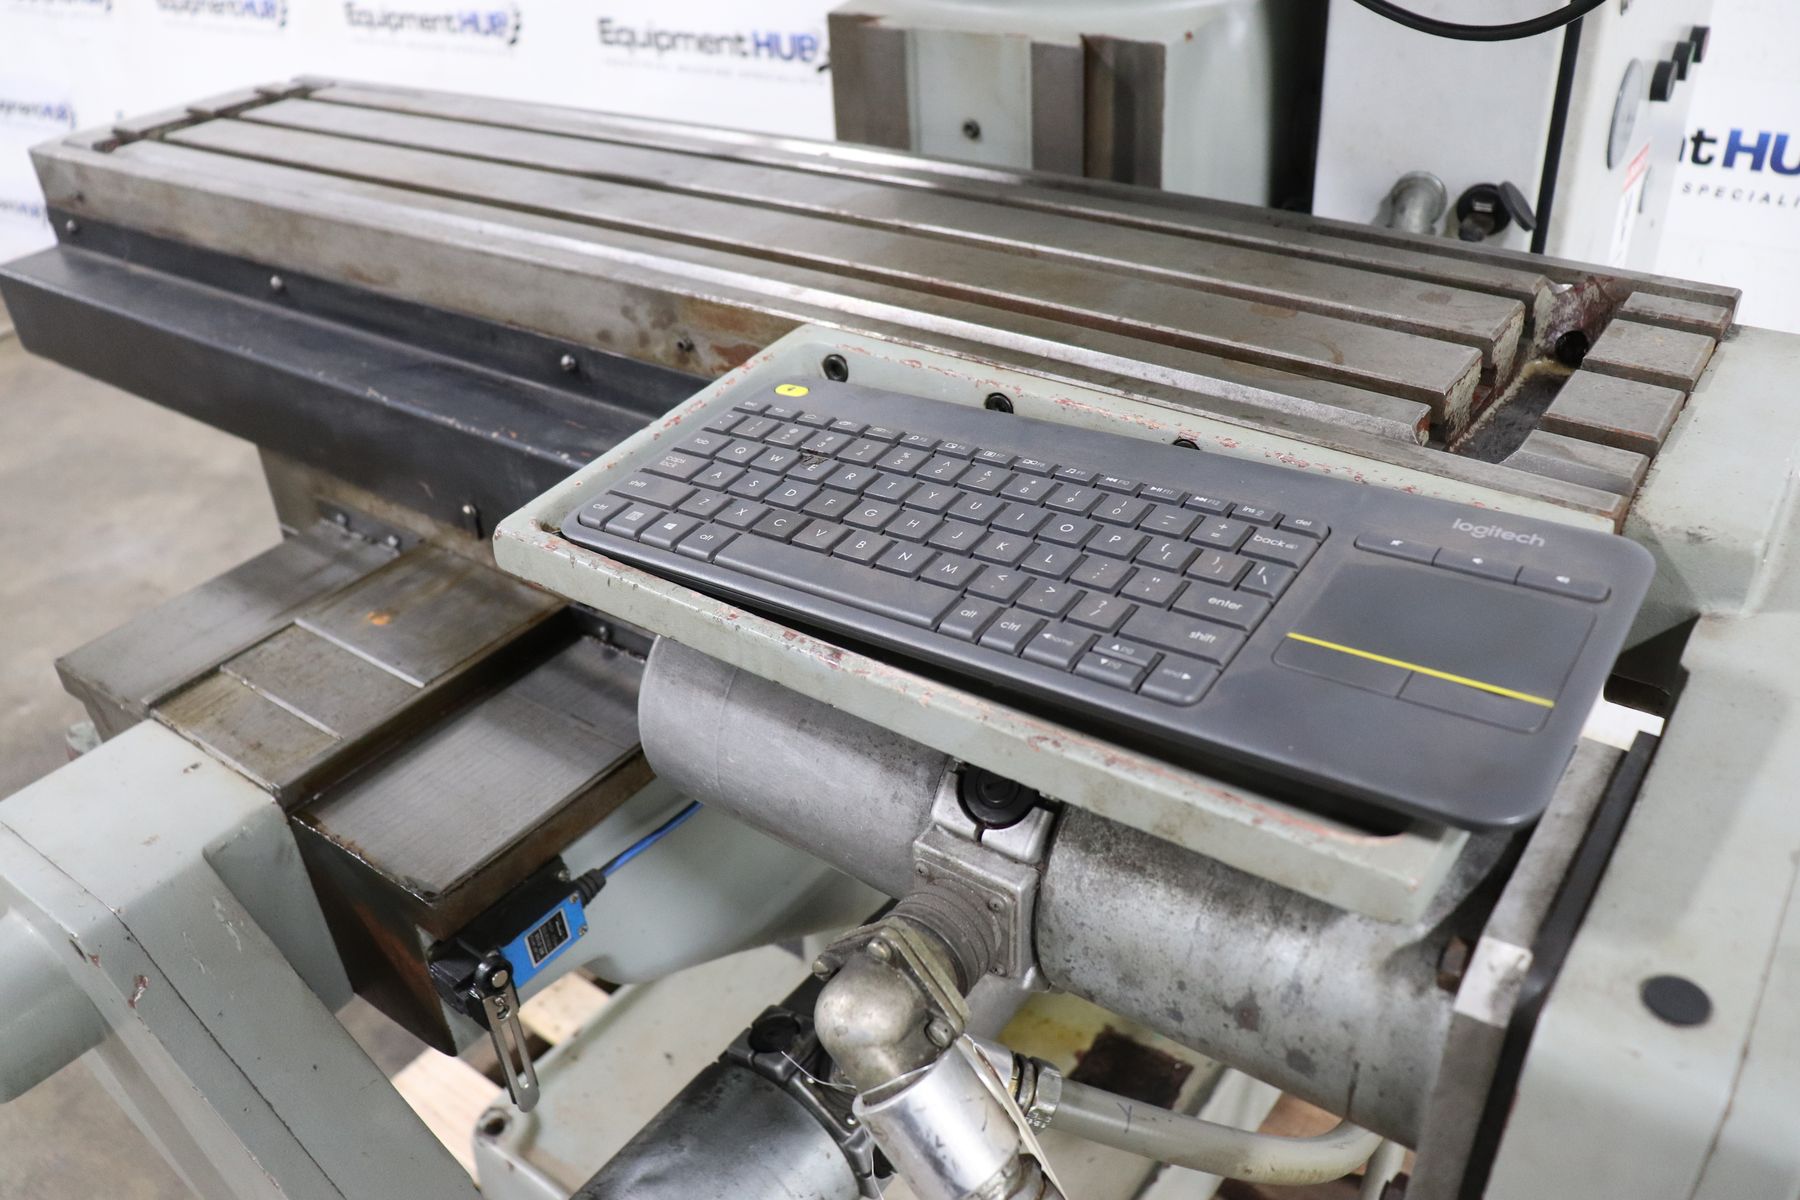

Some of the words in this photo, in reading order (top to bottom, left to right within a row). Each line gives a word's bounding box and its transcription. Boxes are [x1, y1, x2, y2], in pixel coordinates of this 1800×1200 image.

[598, 17, 818, 63] EquipmentHUB
[735, 446, 747, 455] Q
[770, 454, 784, 462] W
[807, 464, 818, 472] E
[711, 471, 723, 479] A
[845, 472, 857, 481] R
[749, 480, 760, 488] S
[887, 481, 897, 490] T
[784, 489, 797, 498] D
[928, 491, 939, 500] Y
[824, 498, 837, 507] F
[970, 502, 982, 511] U
[735, 507, 749, 517] X
[864, 508, 878, 518] G
[773, 518, 787, 527] C
[906, 519, 921, 529] H
[815, 528, 828, 537] V
[951, 531, 964, 540] J
[1452, 518, 1546, 547] logitech
[1108, 535, 1122, 544] P
[1253, 534, 1285, 549] back
[855, 540, 867, 549] B
[995, 541, 1009, 551] K
[897, 551, 913, 561] N
[1044, 554, 1054, 563] L
[940, 563, 959, 574] M
[1207, 596, 1244, 611] enter
[960, 608, 978, 618] alt
[1000, 620, 1022, 632] ctrl
[1188, 630, 1217, 644] shift
